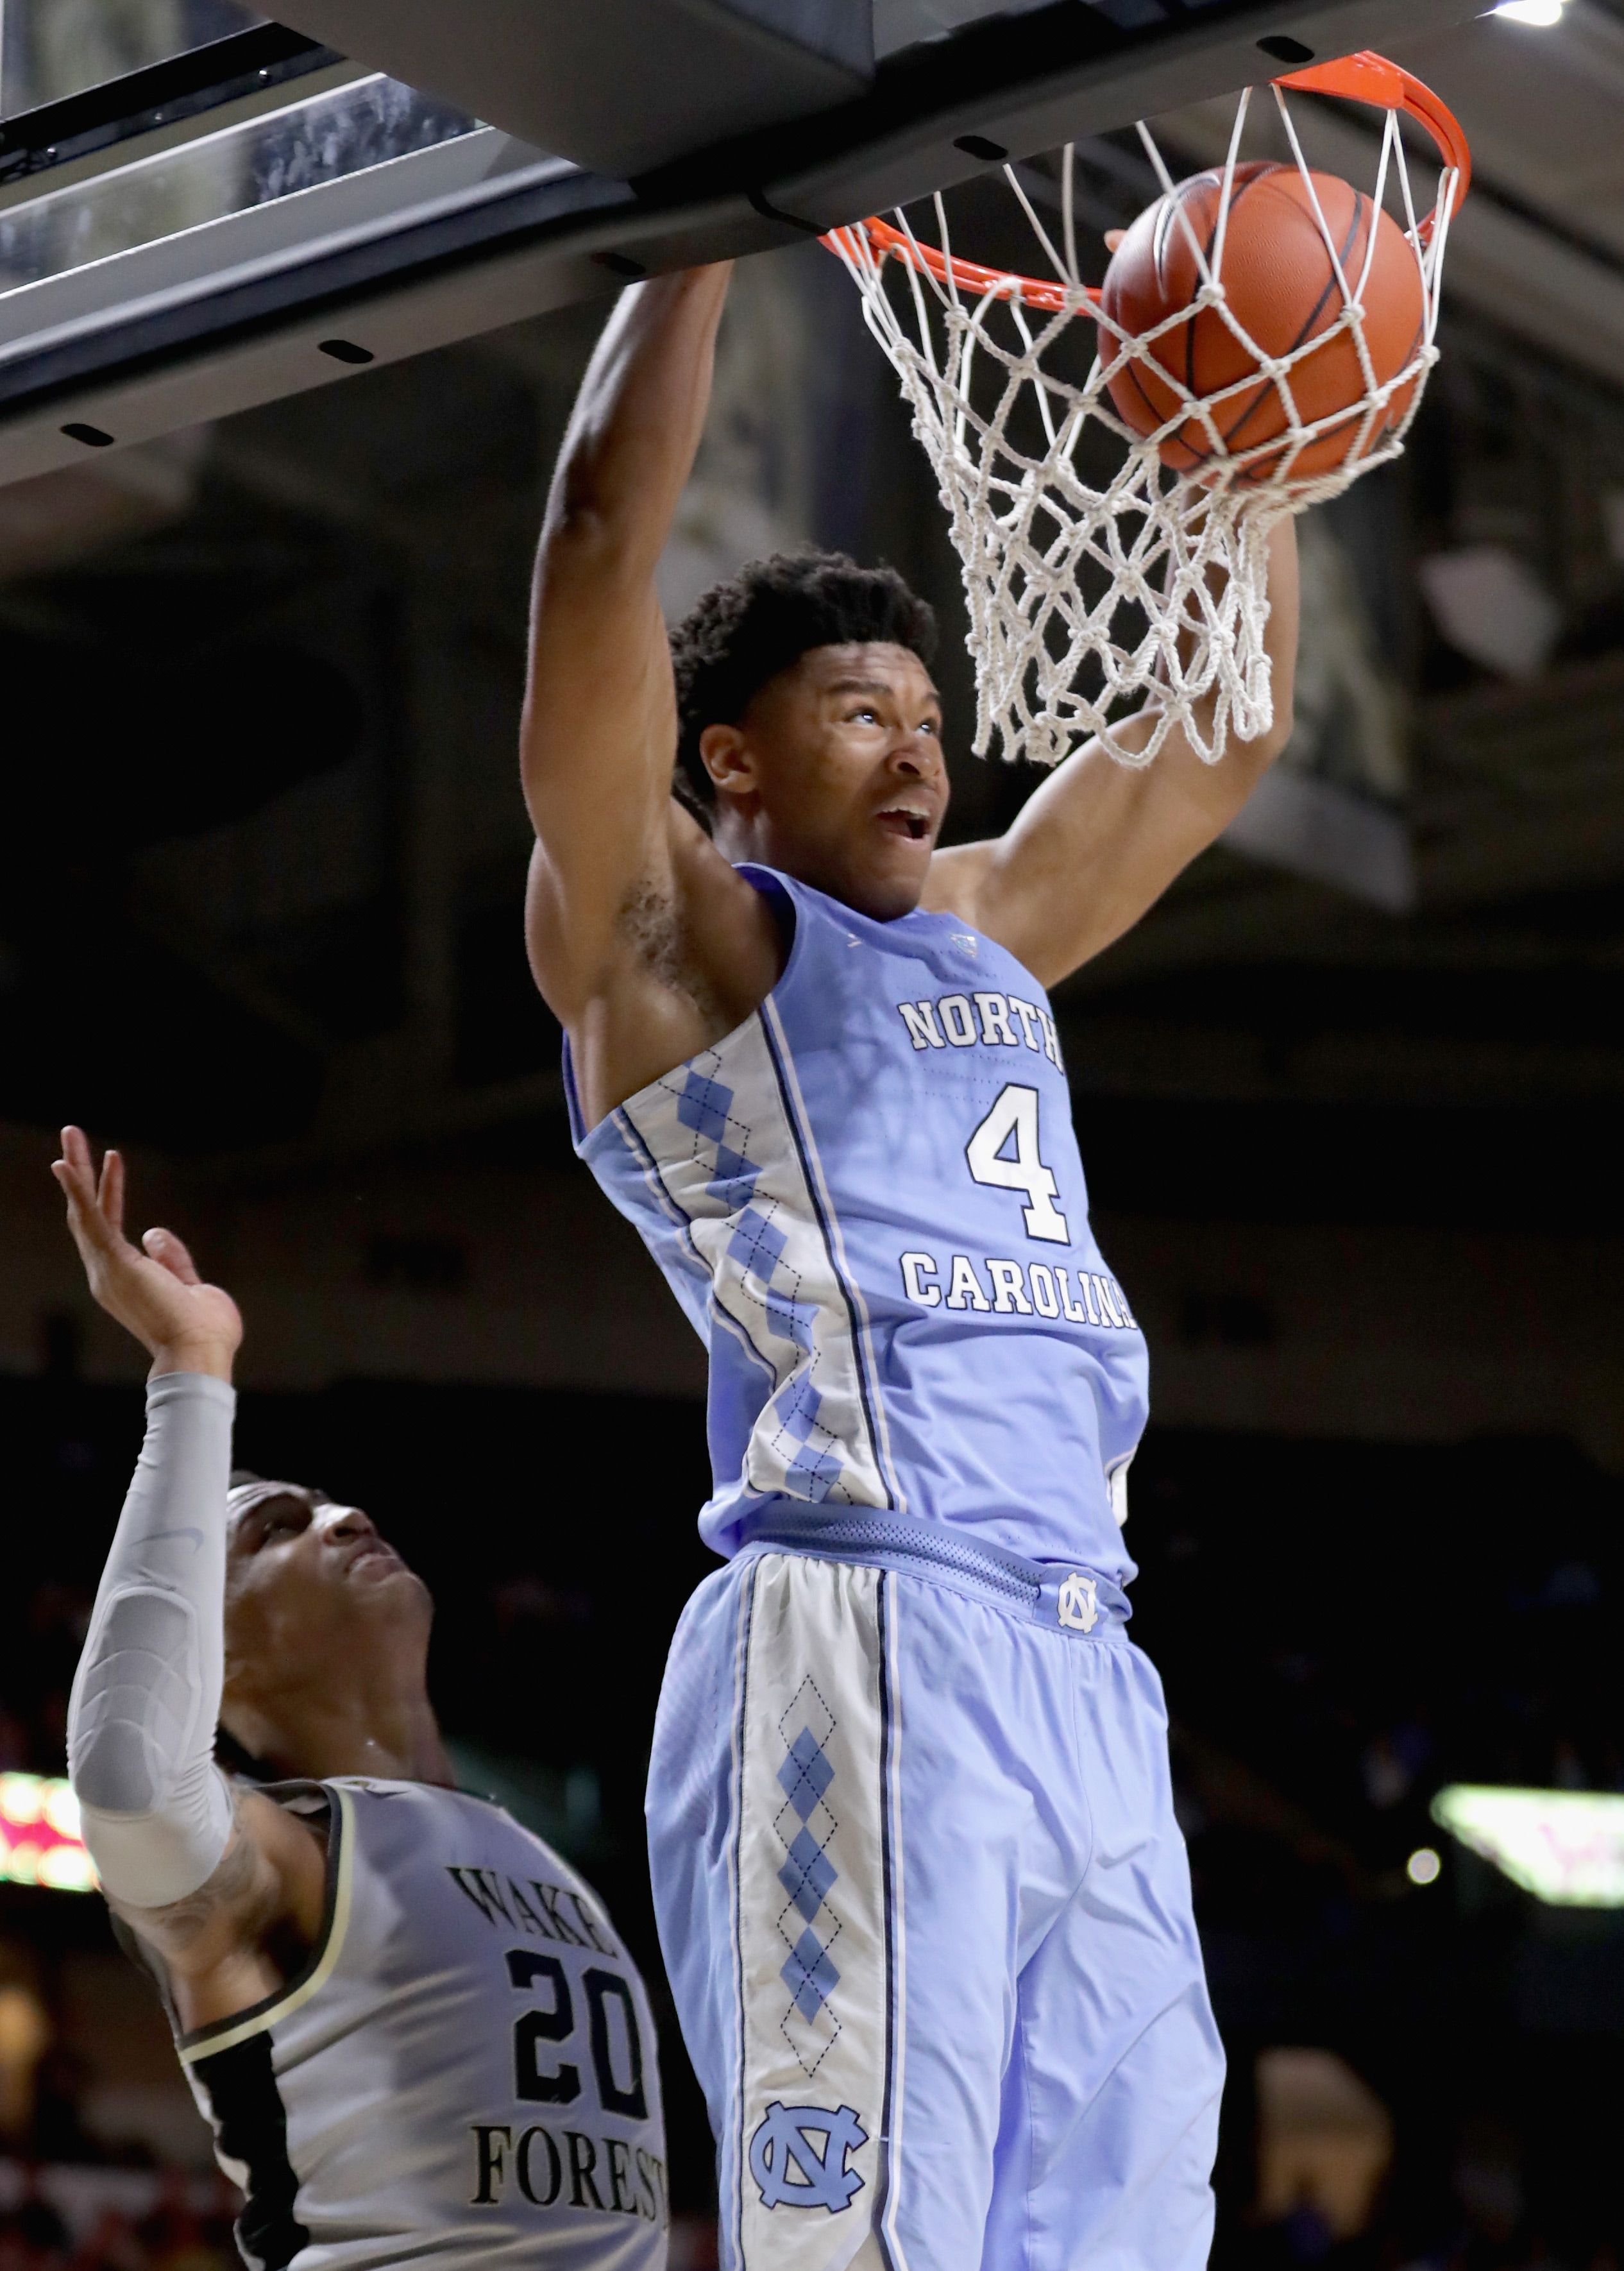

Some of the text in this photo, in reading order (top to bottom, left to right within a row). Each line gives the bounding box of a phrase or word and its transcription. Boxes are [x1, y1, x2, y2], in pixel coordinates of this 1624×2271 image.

[897, 992, 1064, 1076] NORTH
[965, 1082, 1070, 1246] 4
[444, 1866, 619, 1959] WAKE
[505, 1948, 648, 2120] 20
